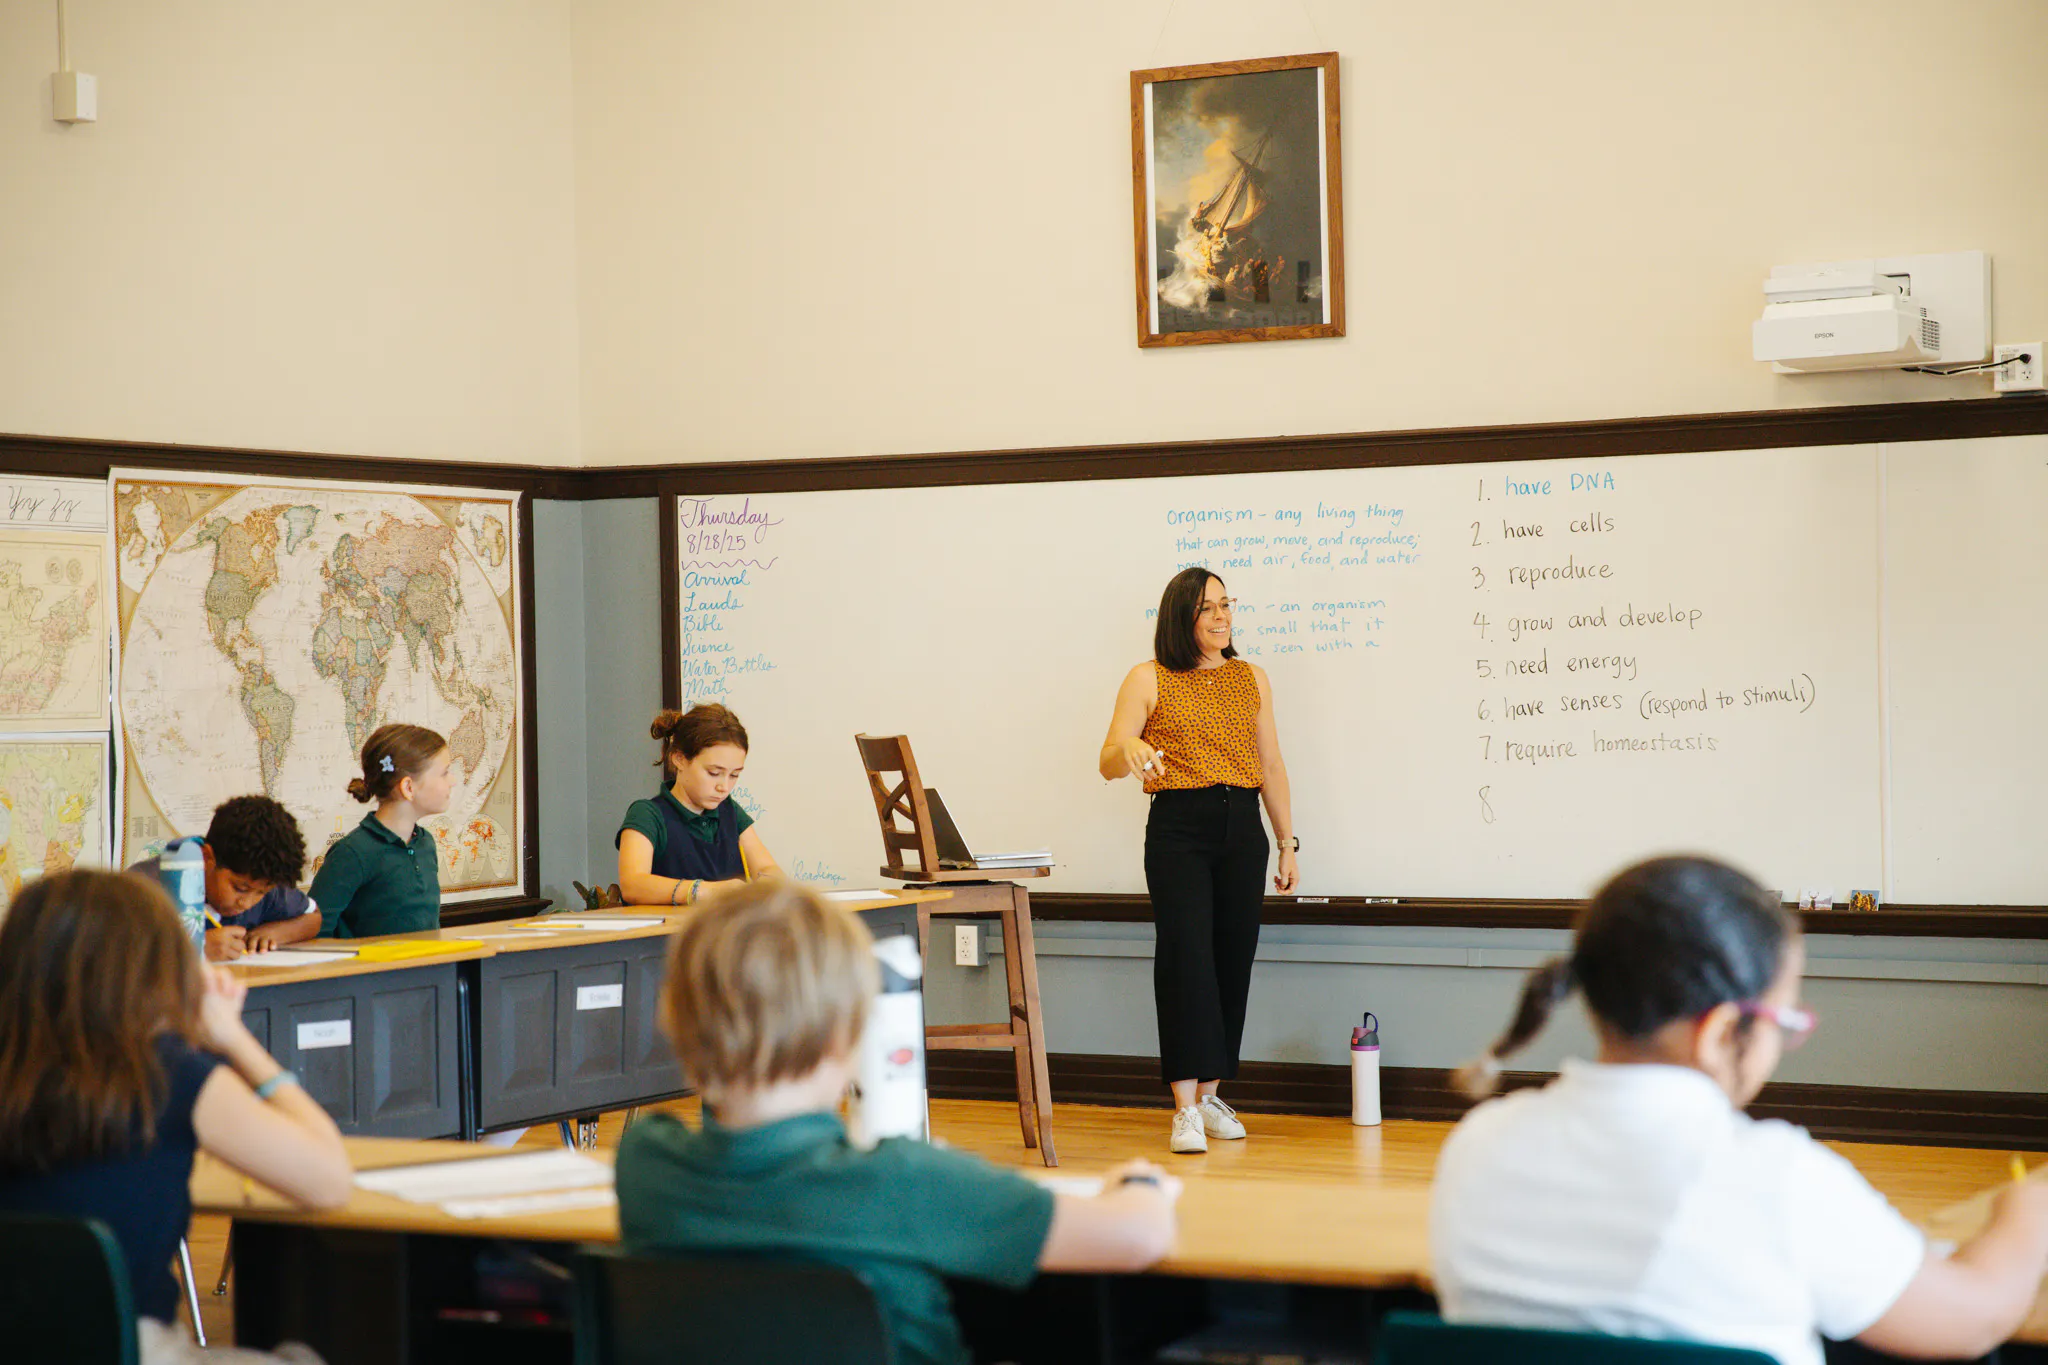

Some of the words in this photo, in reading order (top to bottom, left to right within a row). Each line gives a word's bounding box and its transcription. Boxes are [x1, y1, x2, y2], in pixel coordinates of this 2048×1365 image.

[1477, 479, 1491, 501] 1.
[1505, 476, 1551, 495] have
[1570, 471, 1615, 491] DNA
[680, 497, 784, 544] Thursday
[1274, 510, 1302, 527] any
[1317, 502, 1356, 528] living
[1366, 503, 1404, 527] thing
[686, 528, 746, 554] 8/28/25
[1471, 521, 1490, 547] 2.
[1503, 519, 1544, 540] have
[1569, 511, 1615, 533] cells
[1176, 535, 1203, 553] that
[1207, 536, 1228, 548] can
[1317, 531, 1343, 547] and
[1223, 555, 1252, 569] need
[1340, 554, 1368, 566] and
[1376, 553, 1421, 565] water
[1509, 554, 1614, 590] reproduce
[684, 570, 750, 588] Arrival
[1280, 602, 1300, 613] an
[1312, 599, 1386, 617] organism
[683, 614, 724, 634] Bible
[1257, 621, 1297, 635] small
[1310, 618, 1350, 633] that
[1366, 617, 1384, 631] it
[1508, 616, 1553, 642] grow
[1568, 606, 1607, 628] and
[1619, 602, 1703, 629] develop
[682, 633, 735, 656] Science
[1247, 644, 1262, 655] be
[1273, 643, 1303, 653] seen
[1316, 637, 1352, 651] with
[1365, 640, 1379, 648] a
[682, 659, 720, 678] Water
[722, 653, 777, 674] Bottles
[1476, 659, 1496, 679] 5.
[1505, 647, 1548, 676] need
[1567, 654, 1637, 680] energy
[684, 677, 732, 698] Math
[1477, 699, 1494, 722] 6.
[1503, 697, 1545, 720] have
[1560, 693, 1622, 711] senses
[1639, 688, 1708, 720] (respond
[1716, 690, 1734, 705] to
[1743, 673, 1816, 714] stimuli)
[1505, 740, 1576, 765] require
[1592, 729, 1720, 752] homeostasis
